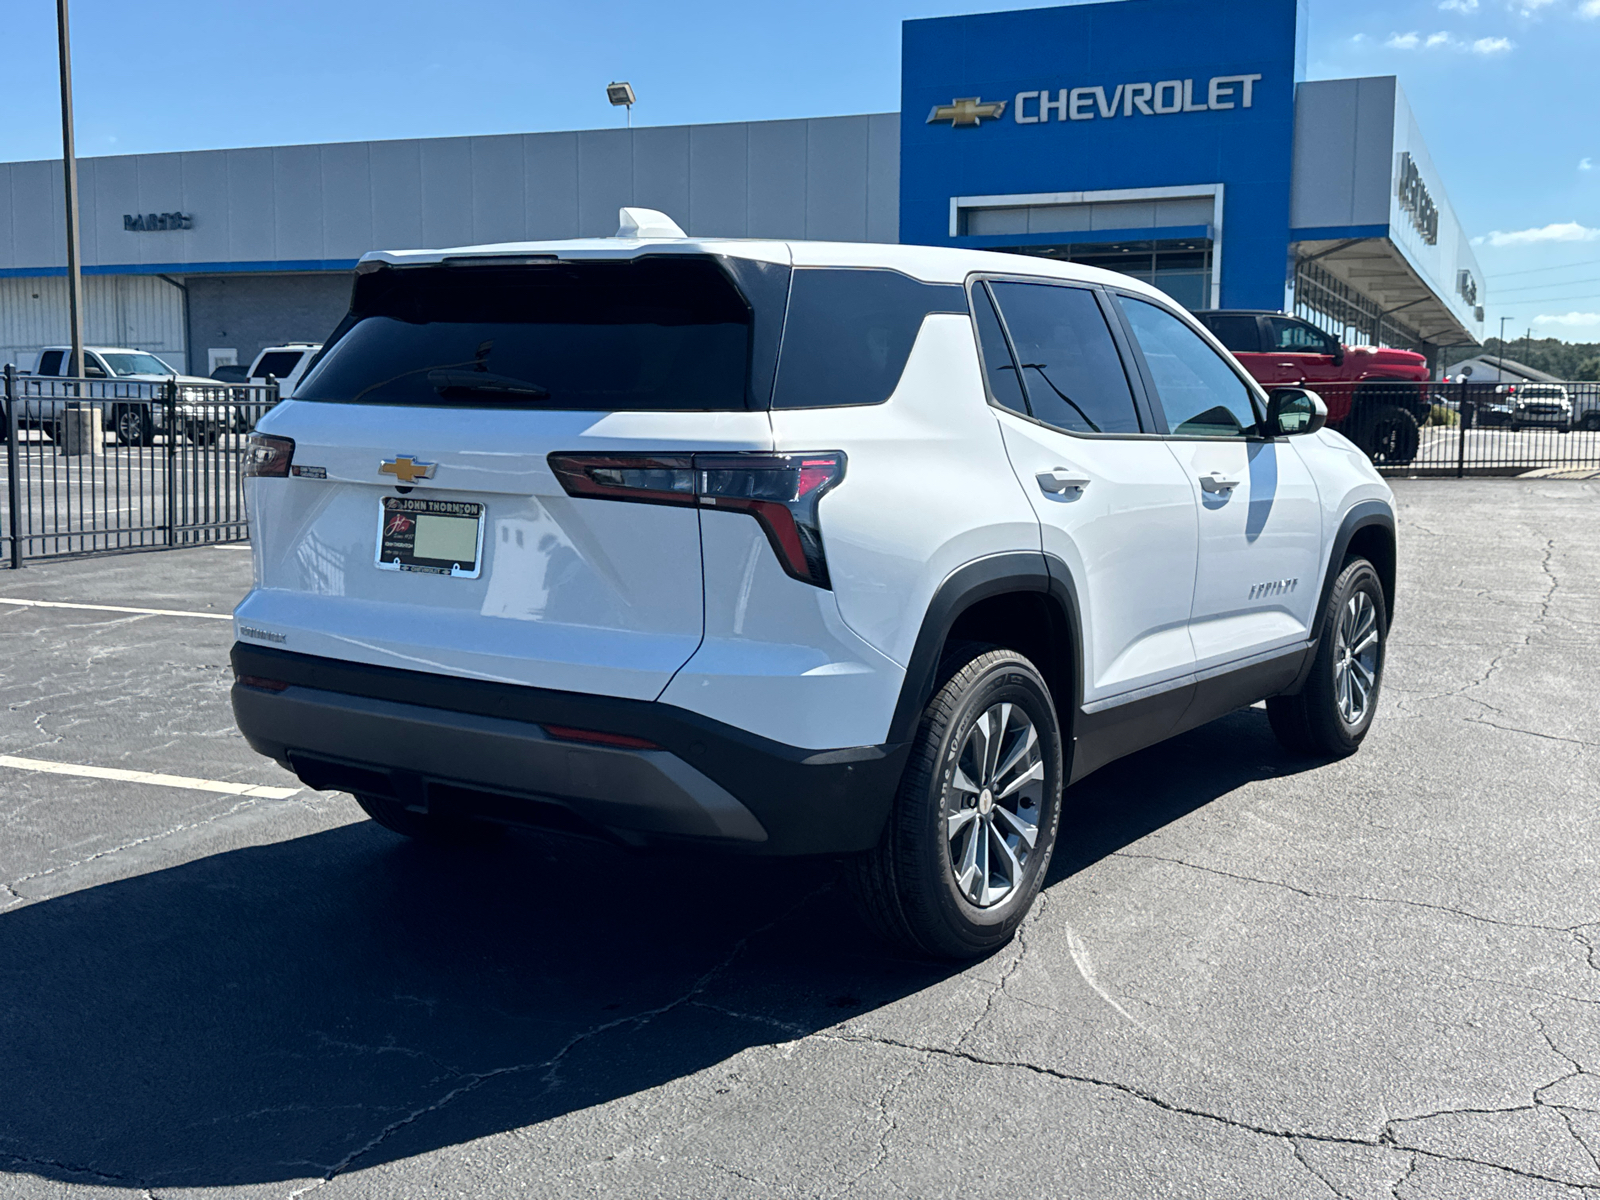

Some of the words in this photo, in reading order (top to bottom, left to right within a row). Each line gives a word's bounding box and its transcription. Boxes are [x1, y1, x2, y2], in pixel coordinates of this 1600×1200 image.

[1014, 73, 1262, 124] CHEVROLET
[403, 500, 427, 511] JOHN
[428, 501, 478, 514] THORNTON
